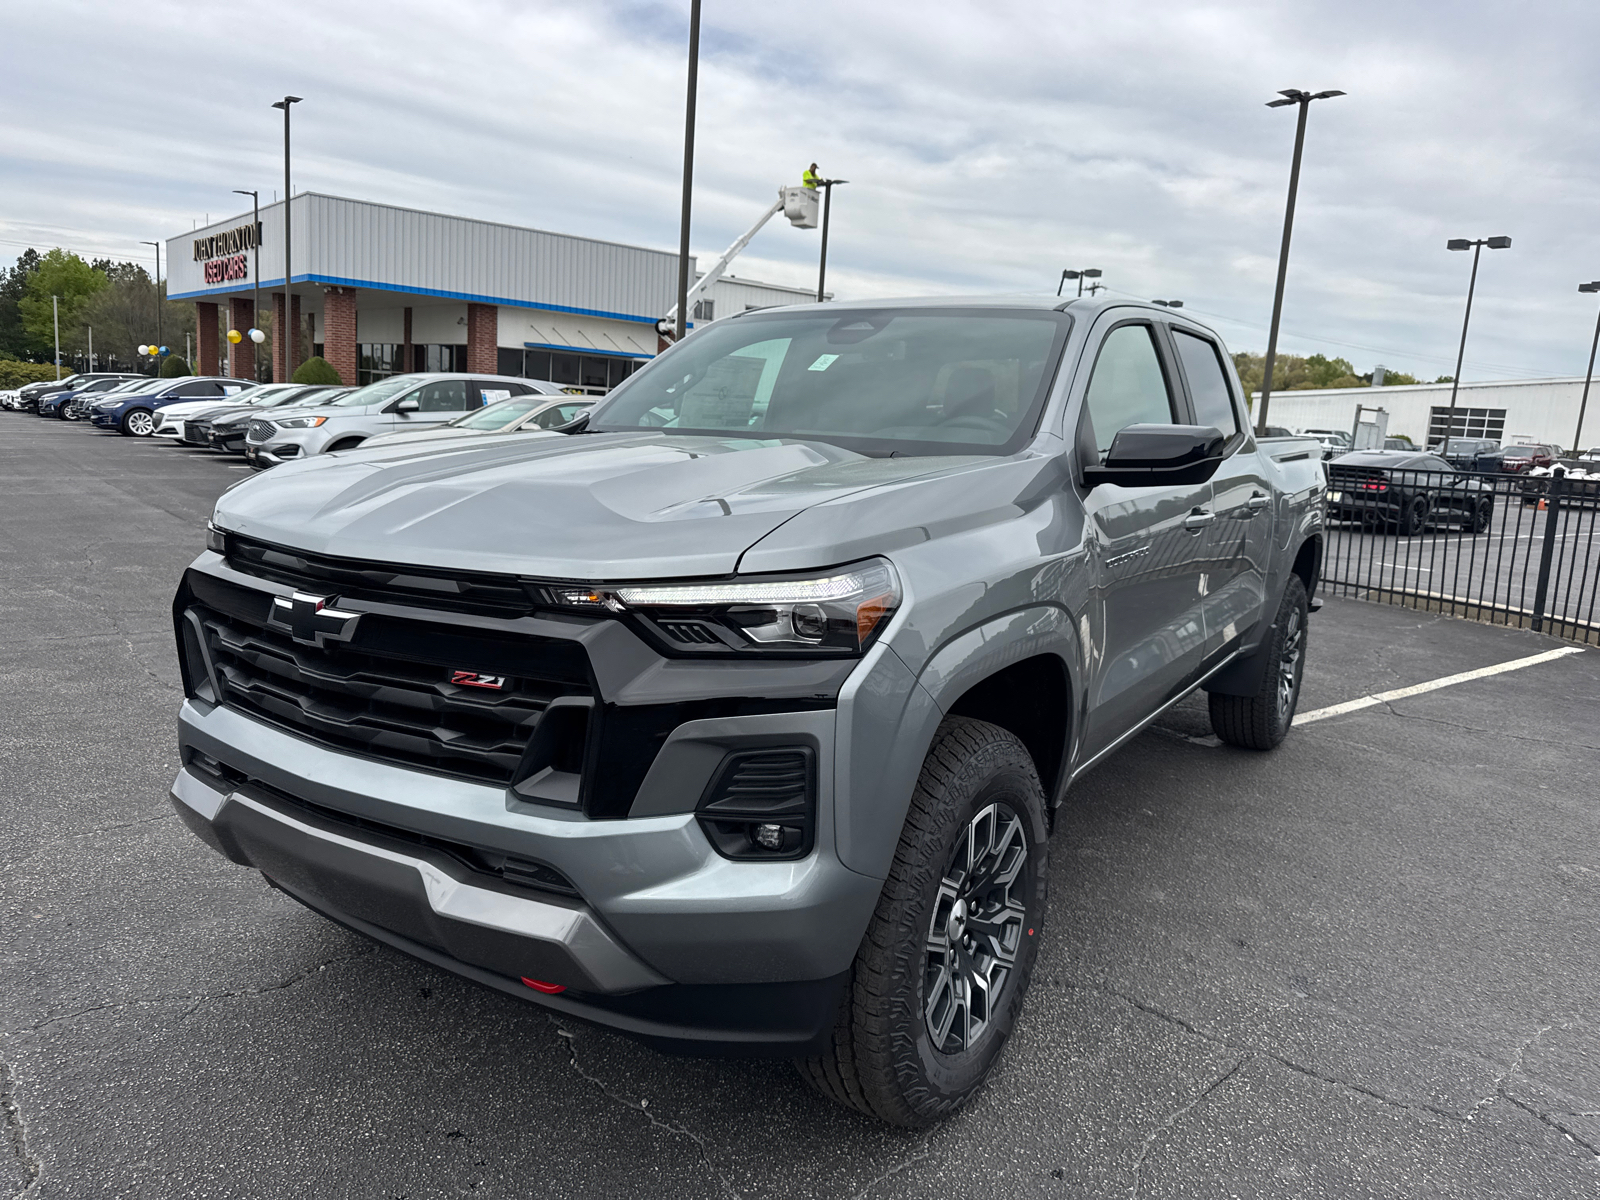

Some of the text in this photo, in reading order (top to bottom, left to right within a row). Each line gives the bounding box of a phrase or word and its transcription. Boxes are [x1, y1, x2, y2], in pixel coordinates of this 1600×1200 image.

[193, 236, 214, 261] JOHN
[204, 254, 247, 284] USED CARS
[451, 670, 505, 690] Z71
